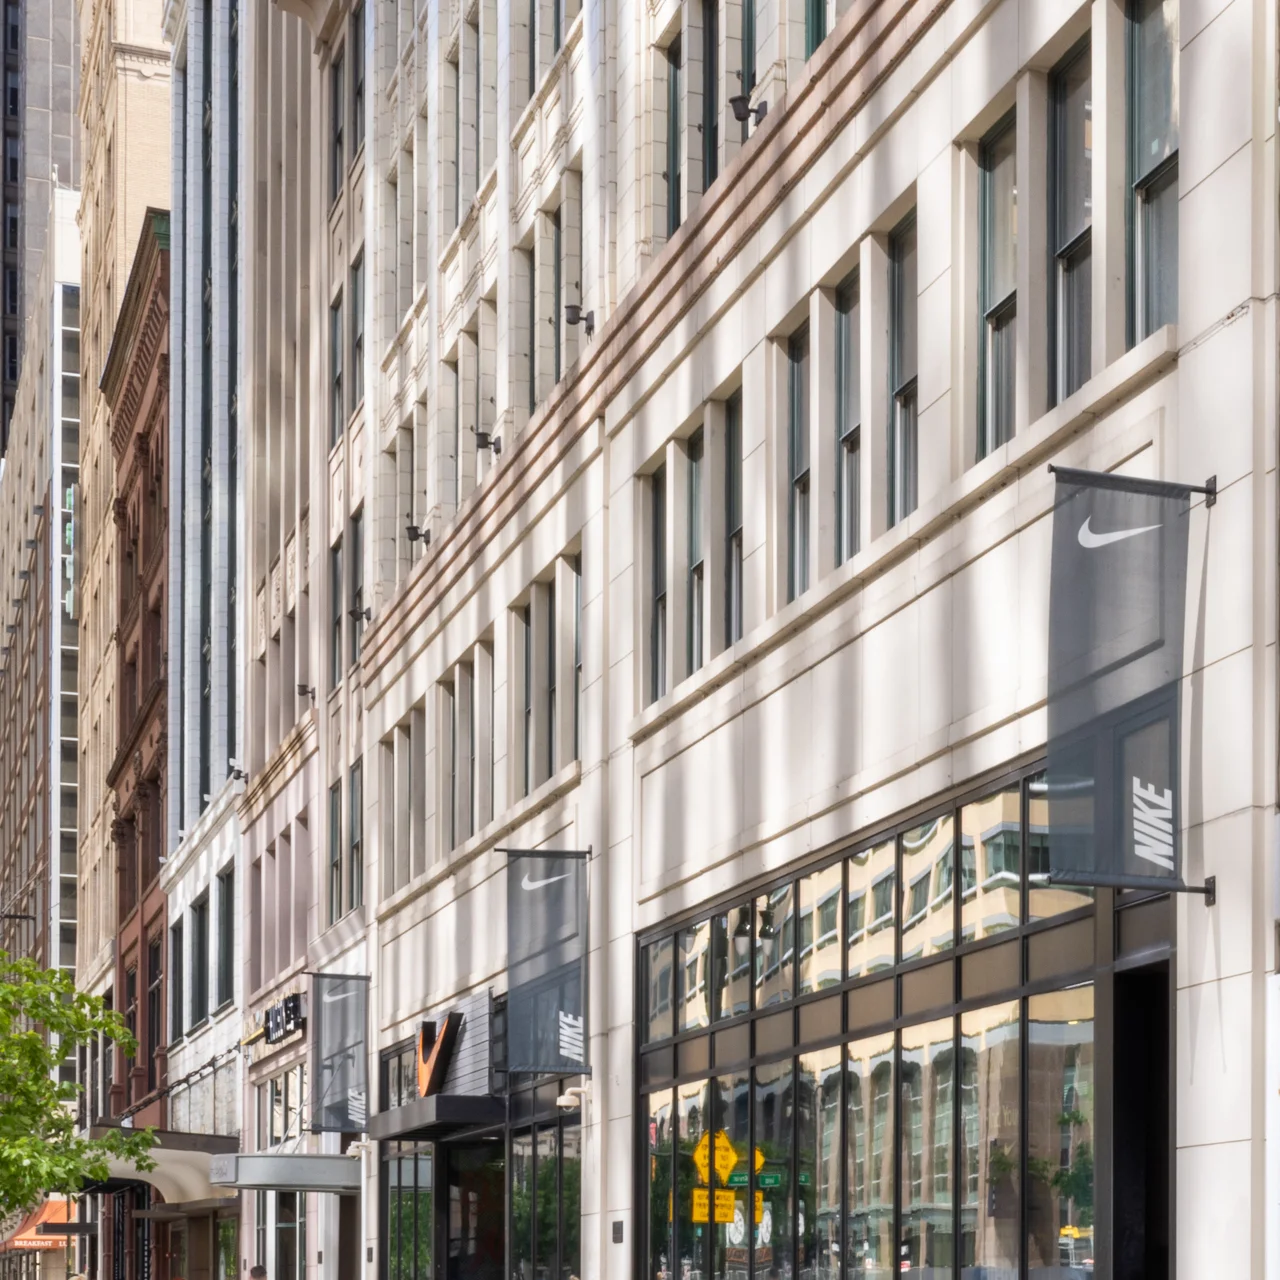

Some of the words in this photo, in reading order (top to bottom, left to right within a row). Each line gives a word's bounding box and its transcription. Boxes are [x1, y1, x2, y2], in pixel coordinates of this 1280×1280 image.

[1133, 775, 1175, 871] NIKE
[559, 1010, 584, 1063] NIKE
[347, 1088, 366, 1126] NIKE
